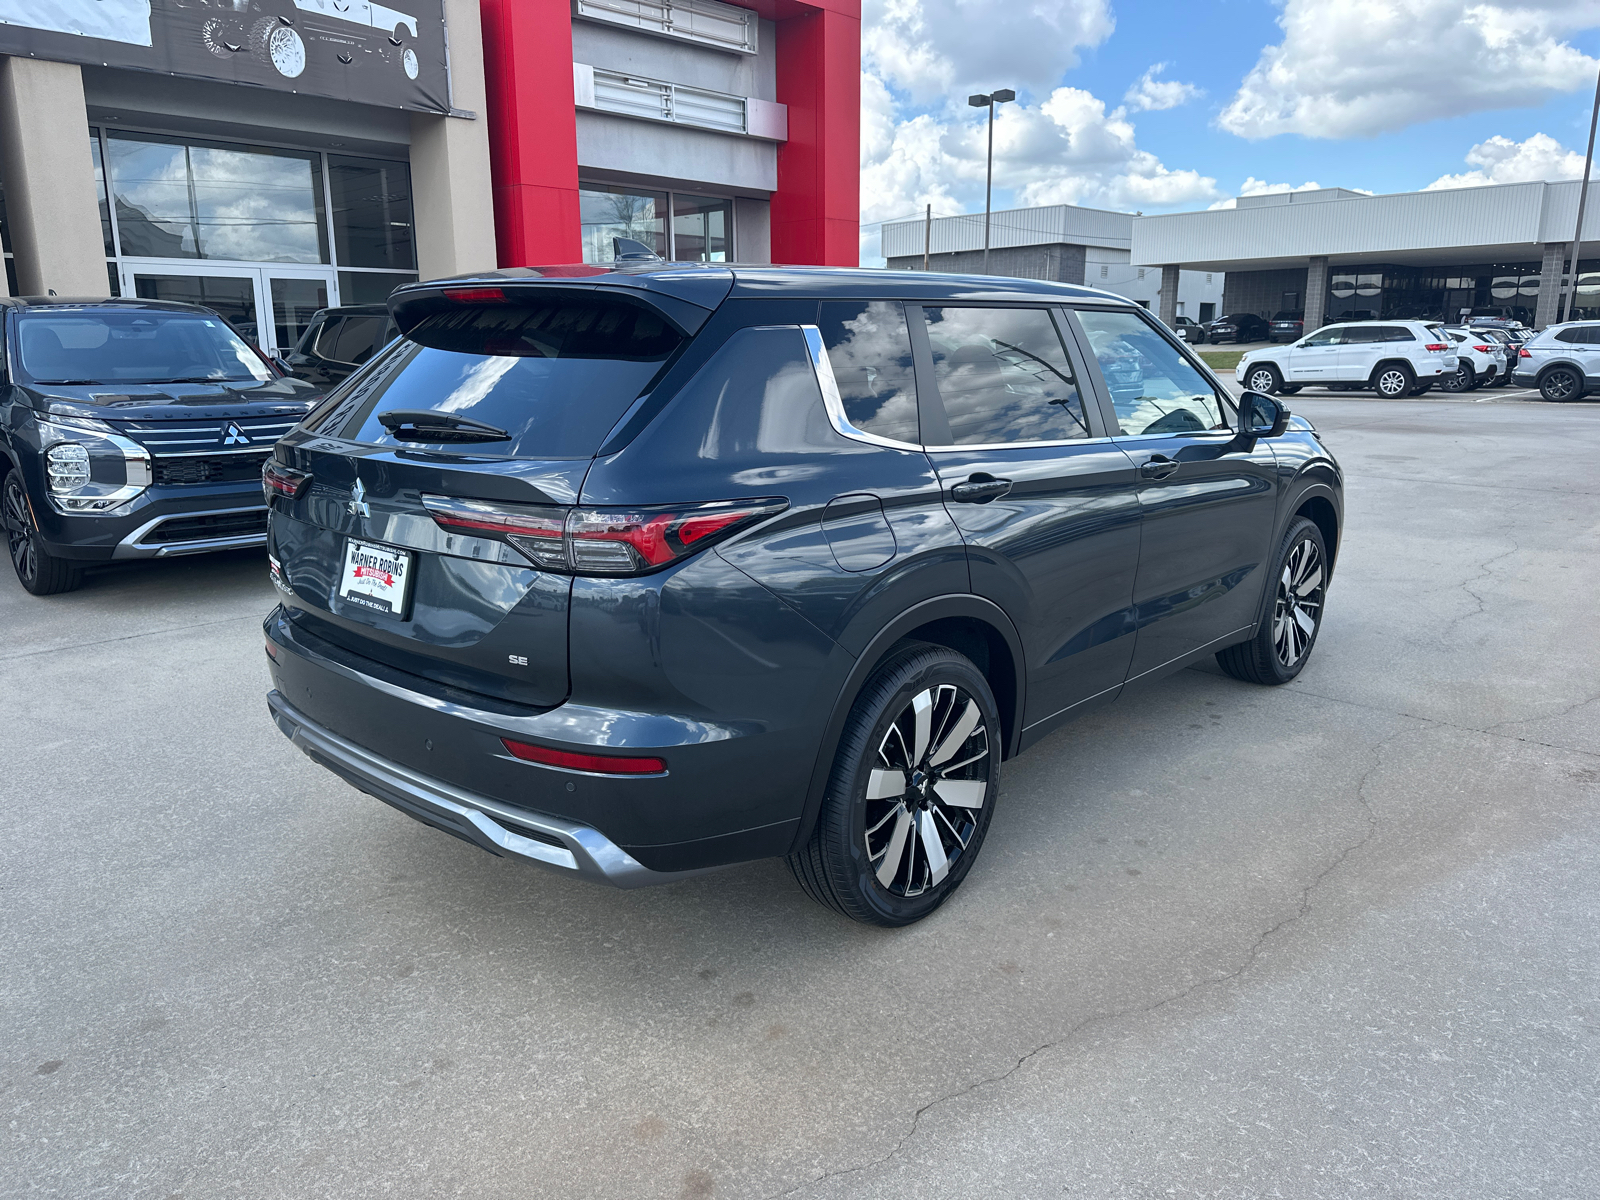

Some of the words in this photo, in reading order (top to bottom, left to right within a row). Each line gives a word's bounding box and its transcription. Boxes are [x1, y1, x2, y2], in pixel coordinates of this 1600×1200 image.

[350, 550, 378, 569] WARNER
[378, 557, 404, 577] ROBINS
[508, 654, 528, 666] SE
